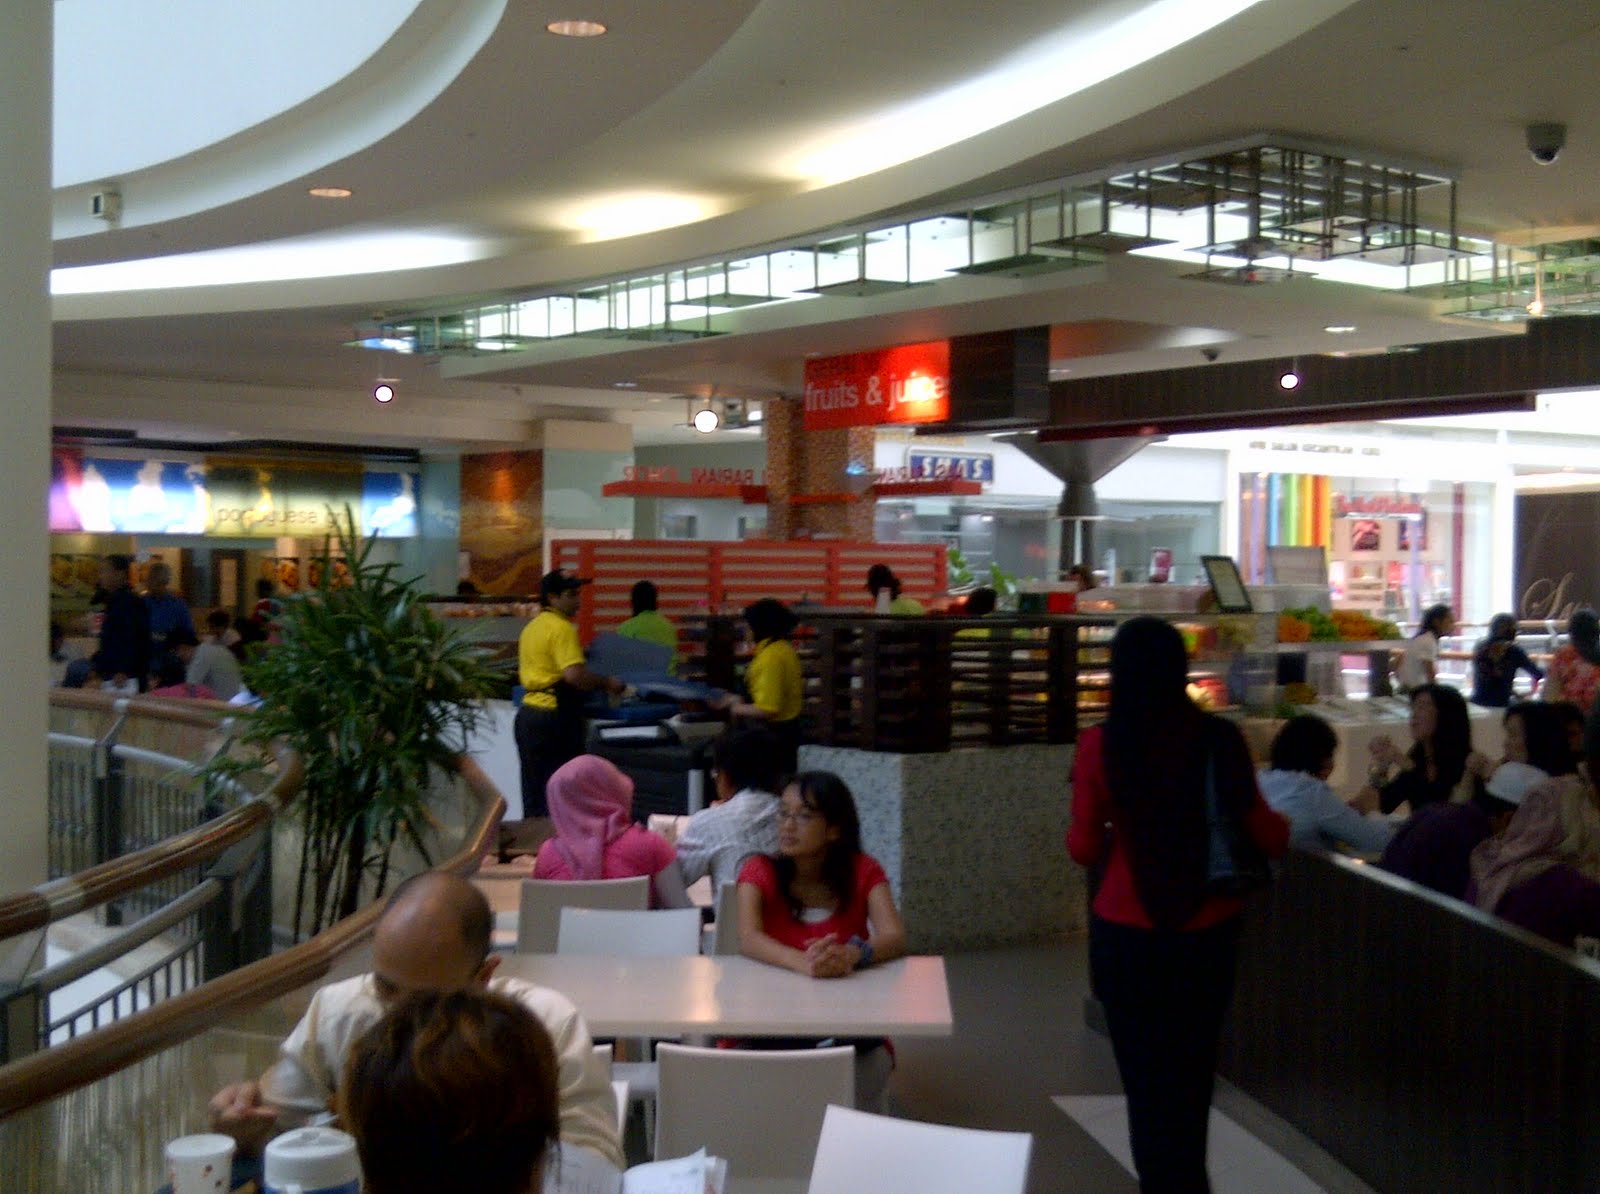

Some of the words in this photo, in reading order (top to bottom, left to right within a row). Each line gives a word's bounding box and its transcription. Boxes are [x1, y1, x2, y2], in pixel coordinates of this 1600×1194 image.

[805, 381, 860, 412] fruits
[865, 375, 883, 406] &
[887, 370, 947, 412] juice
